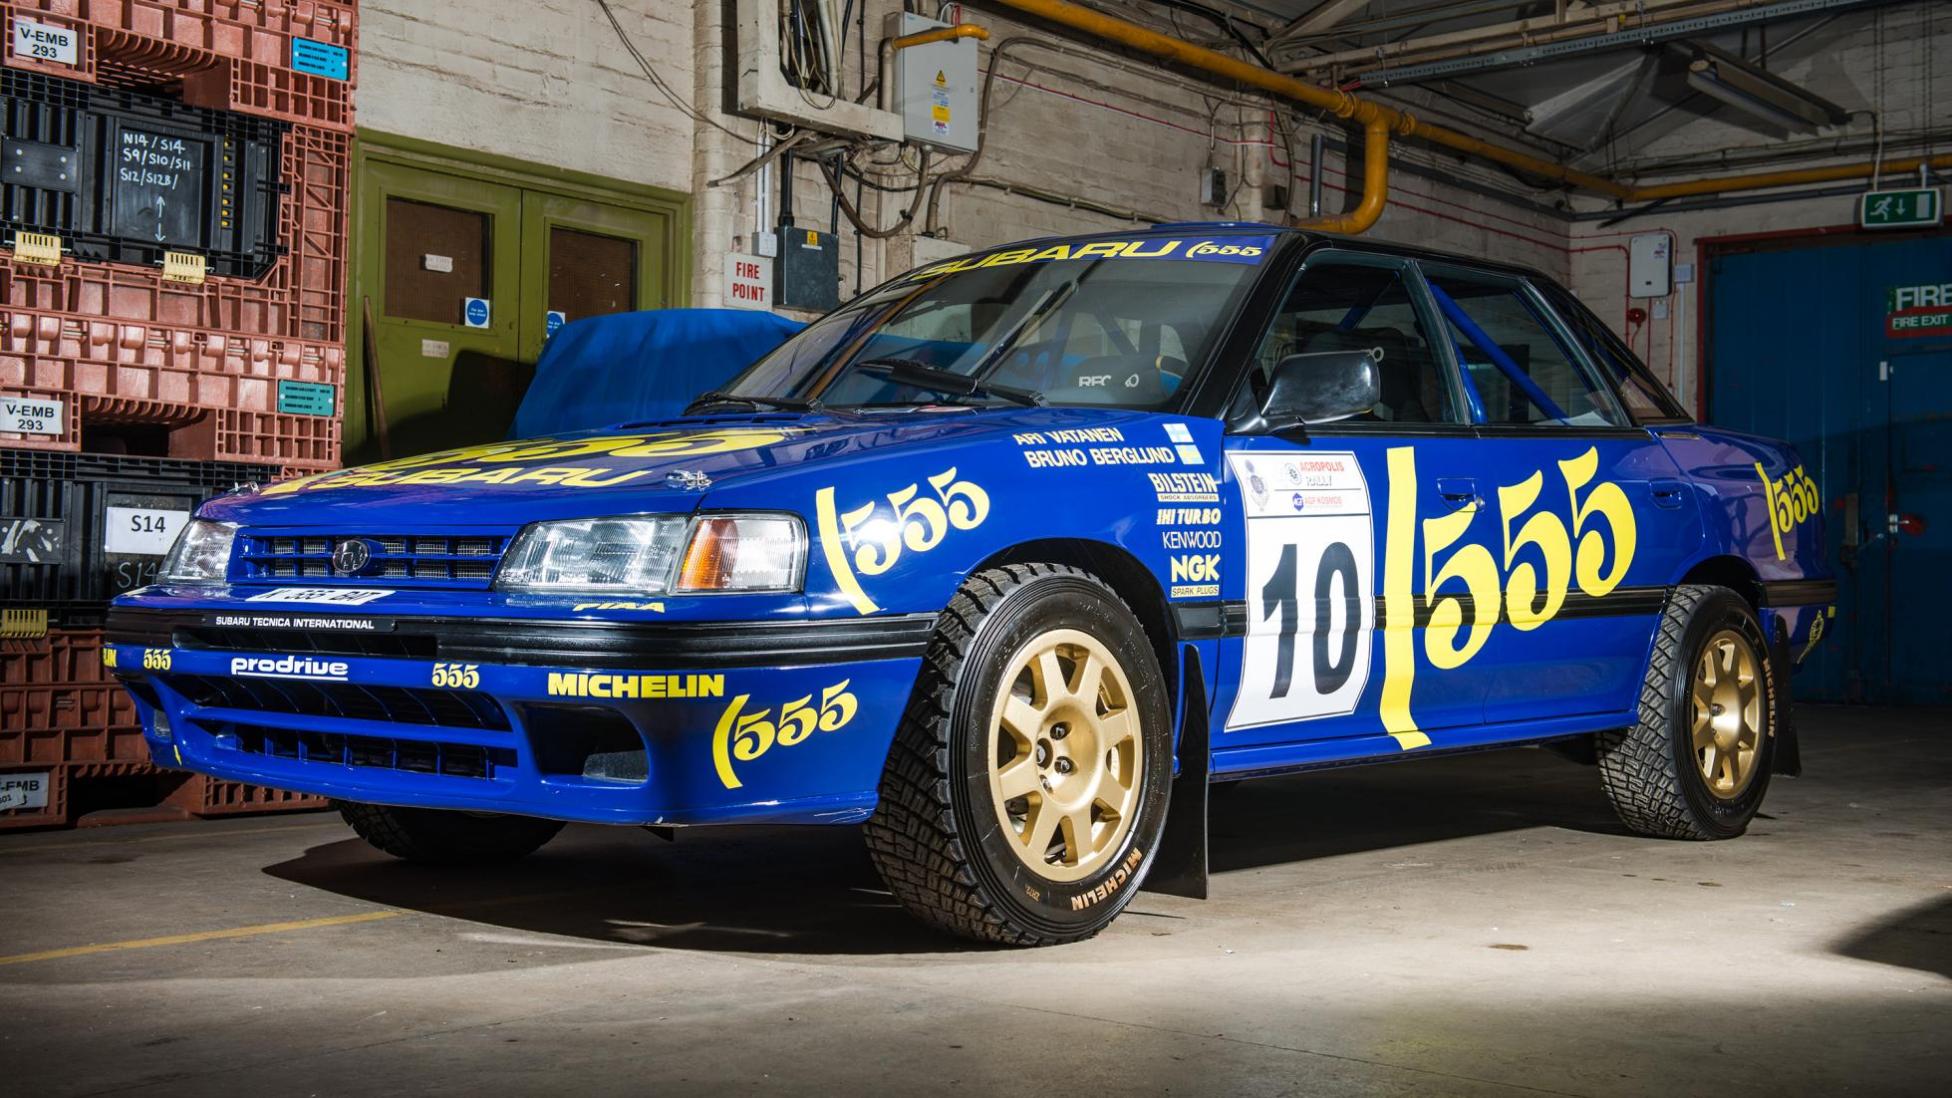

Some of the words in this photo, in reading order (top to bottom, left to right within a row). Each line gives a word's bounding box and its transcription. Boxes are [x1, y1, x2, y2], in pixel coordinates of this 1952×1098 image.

[20, 27, 69, 47] V-EMB
[32, 44, 57, 58] 293
[912, 240, 1182, 281] SUBARU
[736, 262, 760, 280] FIRE
[732, 283, 765, 302] POINT
[1896, 283, 1952, 311] FIRE
[1892, 317, 1919, 330] FIRE
[1921, 314, 1950, 326] EXIT
[6, 404, 55, 418] V-EMB
[17, 419, 44, 431] 293
[1012, 431, 1047, 446] ARI
[1045, 427, 1125, 443] VATANEN
[1023, 448, 1088, 468] BRUNO
[1089, 446, 1176, 465] BERGLUND
[309, 467, 651, 488] SUBARU
[1148, 472, 1218, 493] BILSTEIN
[131, 515, 166, 533] S14
[1177, 507, 1222, 525] TURBO
[1162, 531, 1222, 549] KENWOOD
[1170, 554, 1221, 582] NGK
[1172, 587, 1195, 597] SPARK
[1196, 585, 1219, 595] PLUGS
[216, 616, 250, 626] SUBARU
[252, 617, 291, 628] TECNICA
[293, 619, 375, 630] INTERNATIONAL
[1262, 541, 1362, 699] 10
[144, 648, 171, 670] 555
[231, 655, 349, 676] prodrive
[432, 662, 480, 689] 555
[548, 673, 725, 699] MICHELIN
[1071, 847, 1143, 911] MICHELIN
